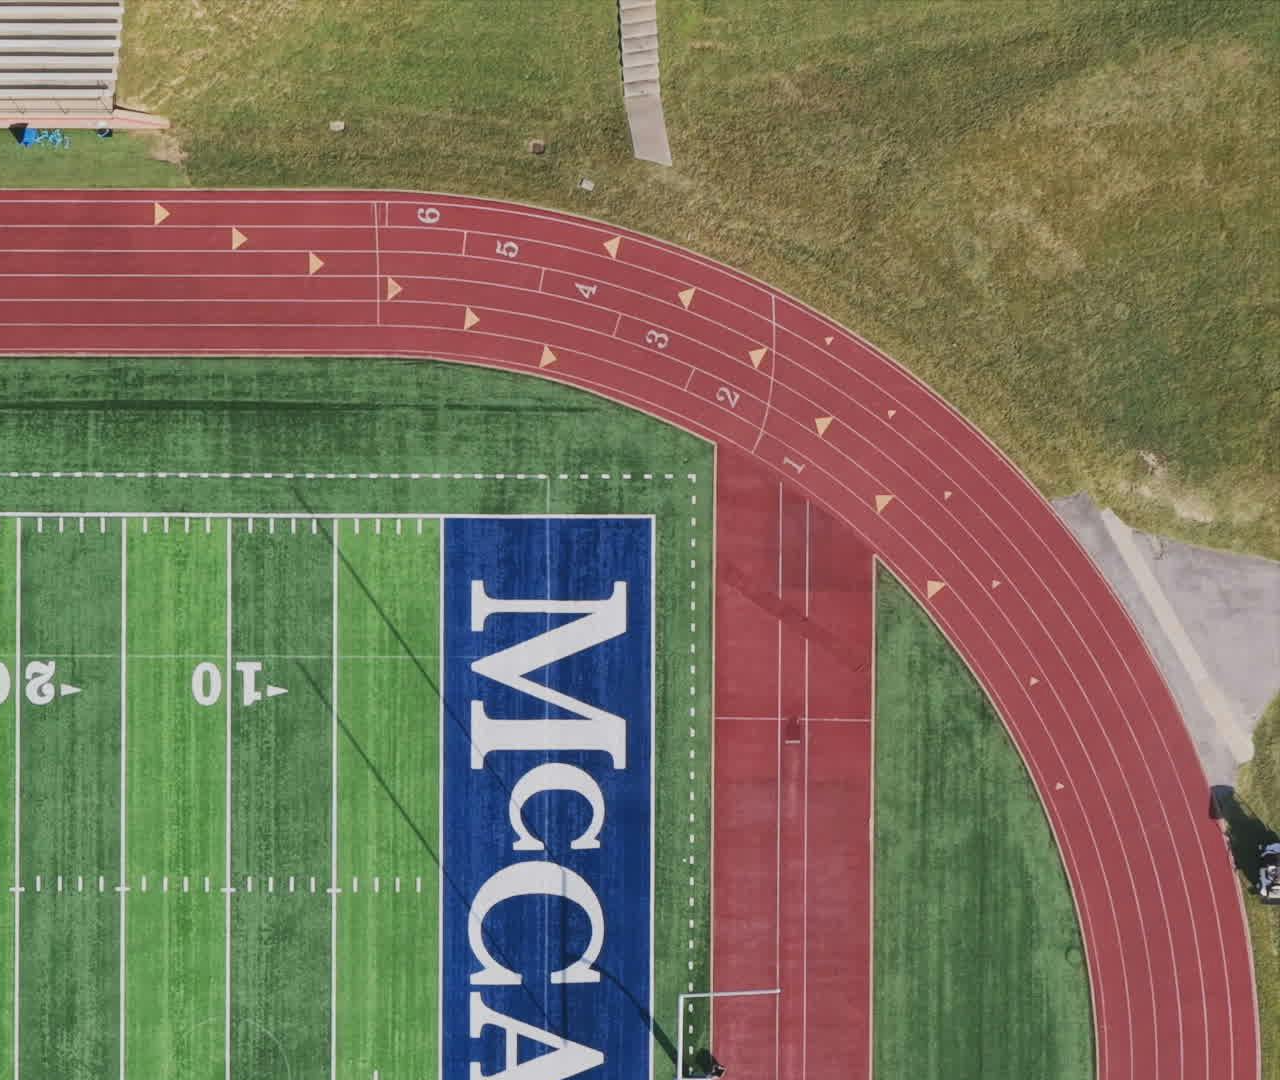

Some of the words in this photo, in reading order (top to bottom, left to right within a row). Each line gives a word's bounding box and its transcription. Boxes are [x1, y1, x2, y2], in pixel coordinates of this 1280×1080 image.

[417, 207, 441, 225] 6
[496, 239, 519, 259] 5
[574, 281, 598, 299] 4
[645, 329, 670, 350] 3
[715, 387, 740, 408] 2
[783, 456, 806, 474] 1
[191, 661, 263, 705] 10
